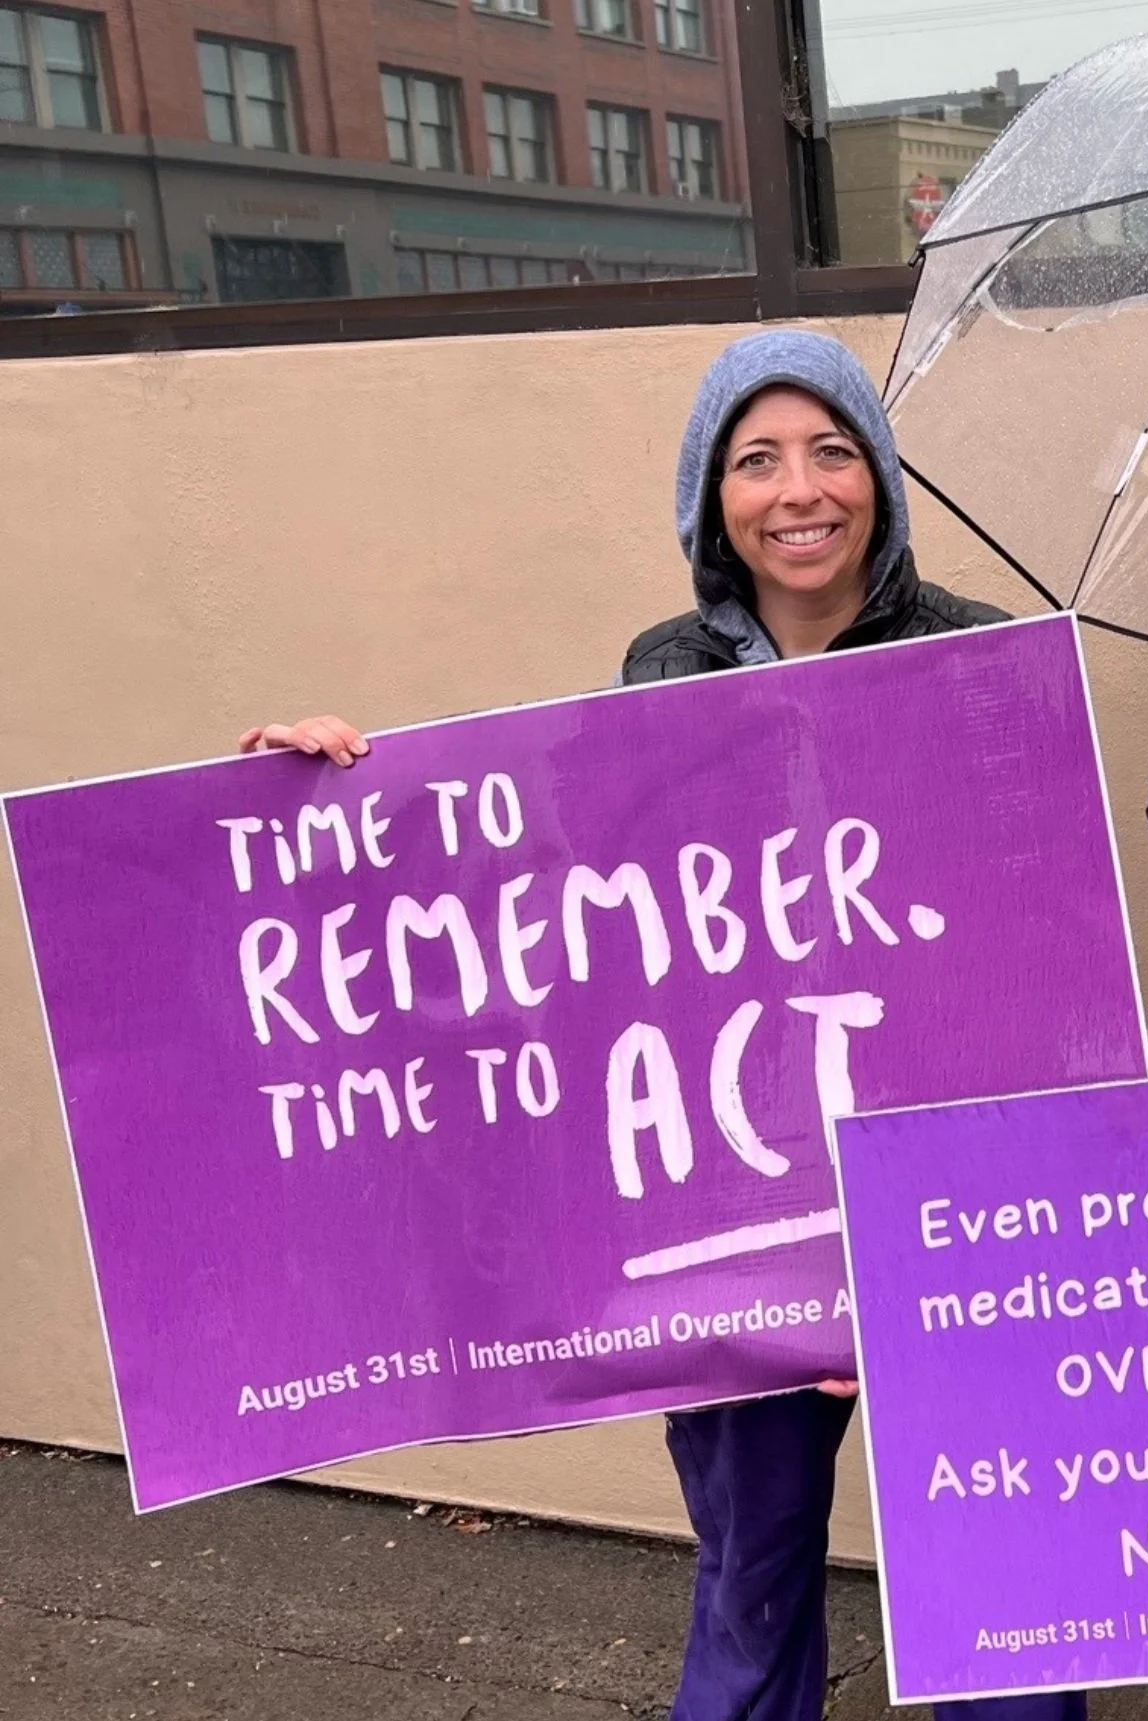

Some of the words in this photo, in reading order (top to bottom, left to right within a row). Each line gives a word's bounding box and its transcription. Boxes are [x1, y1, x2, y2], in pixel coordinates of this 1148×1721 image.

[425, 772, 524, 856] TO
[239, 817, 945, 1045] REMEMBER.
[466, 1041, 560, 1124] TO
[605, 990, 885, 1199] ACT
[920, 1198, 1058, 1249] Even
[238, 1363, 360, 1415] August
[366, 1348, 440, 1384] 31st
[468, 1314, 661, 1369] International
[668, 1299, 823, 1342] Overdose
[928, 1448, 1031, 1501] Ask
[975, 1624, 1058, 1653] August
[1063, 1618, 1115, 1642] 31st
